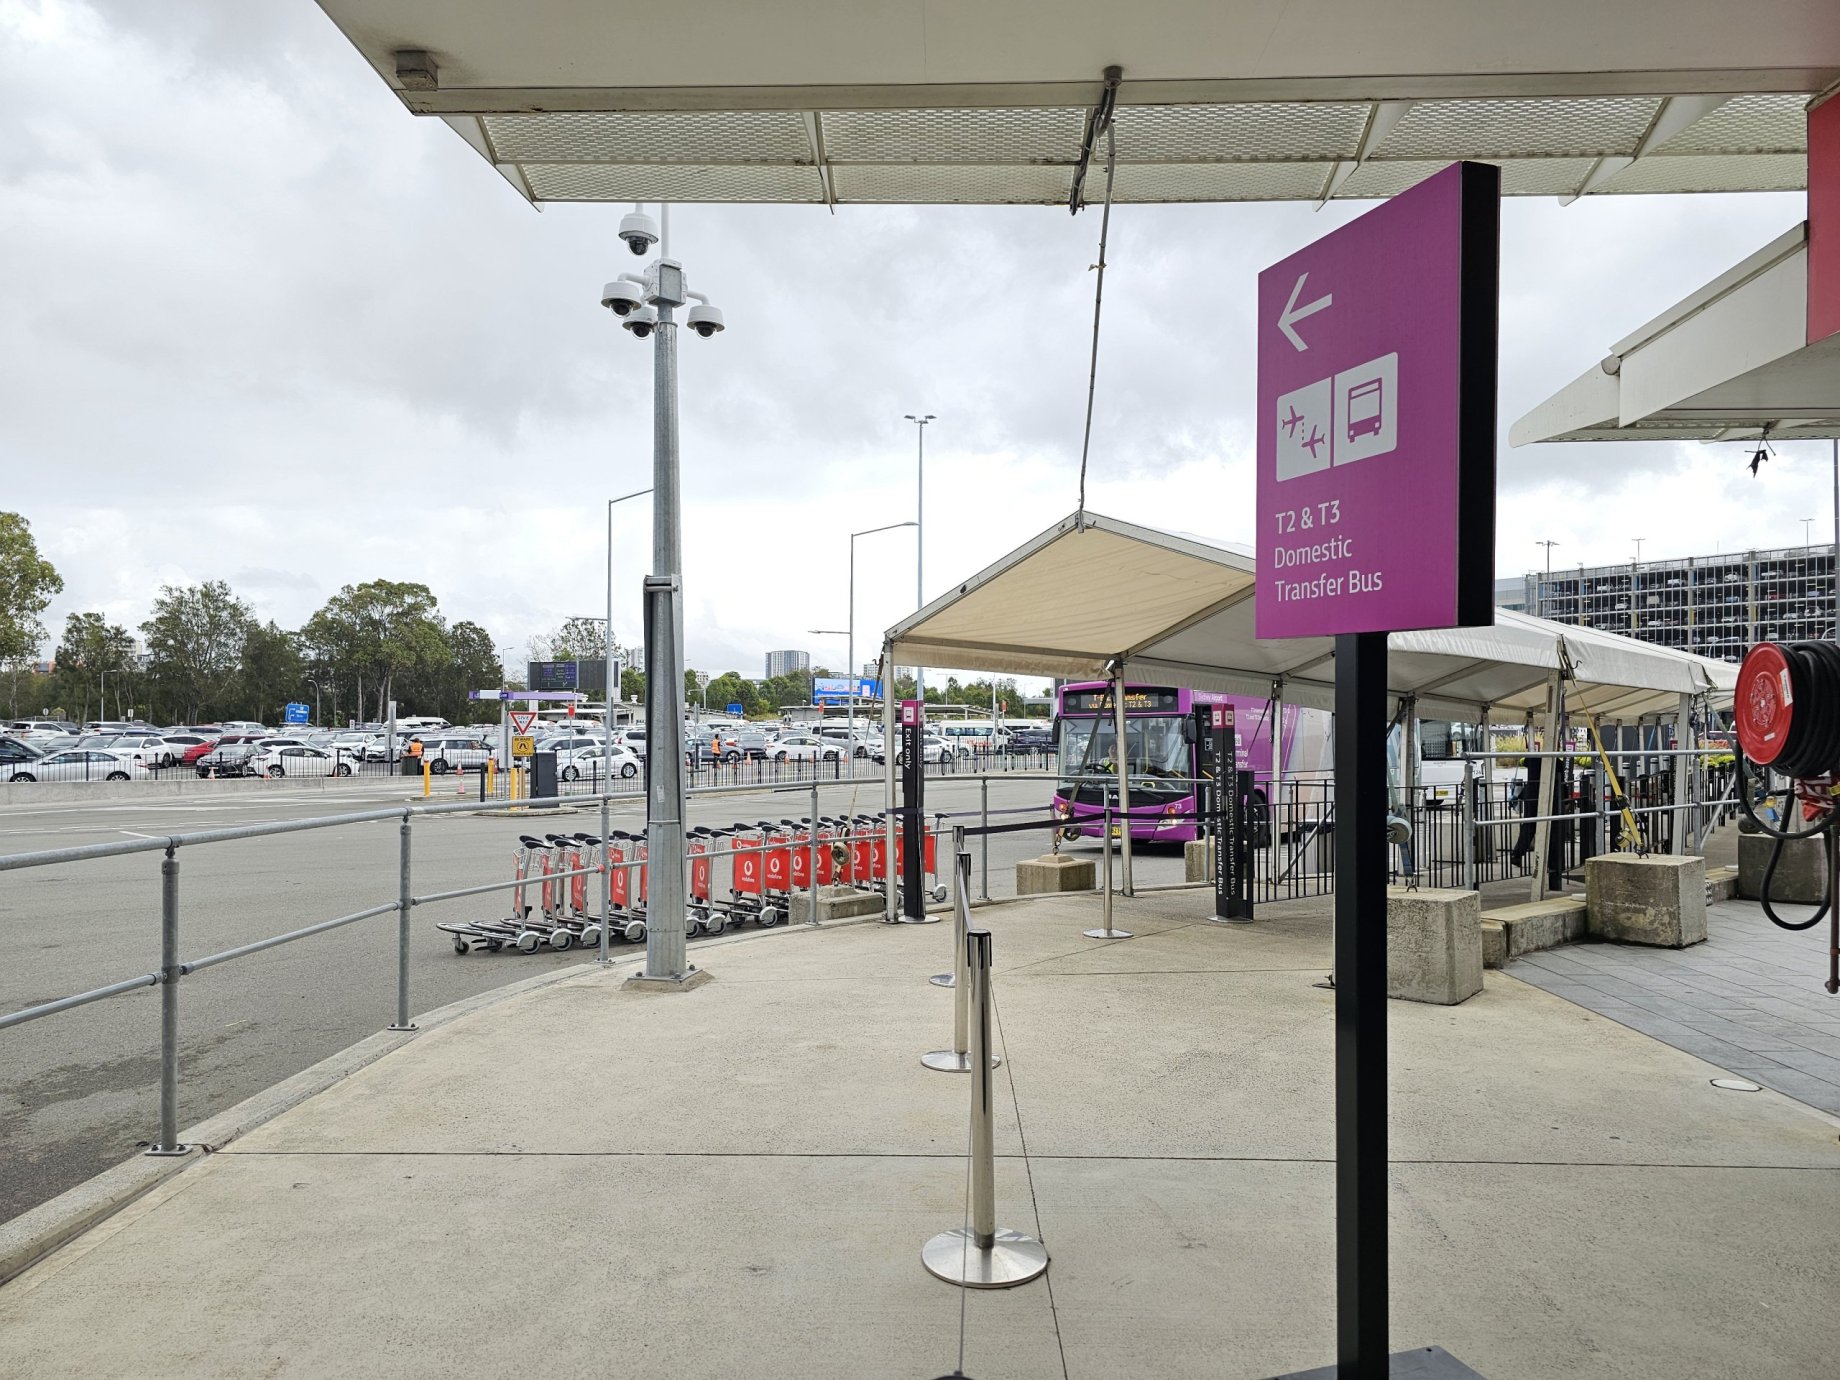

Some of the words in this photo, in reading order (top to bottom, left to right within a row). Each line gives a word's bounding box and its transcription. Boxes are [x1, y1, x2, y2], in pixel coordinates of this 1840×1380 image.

[1275, 511, 1296, 534] T2
[1300, 507, 1313, 529] &
[1318, 500, 1340, 525] T3
[1274, 534, 1353, 569] Domestic
[1274, 573, 1344, 602] Transfer
[1349, 570, 1383, 594] Bus
[904, 748, 912, 769] only
[1215, 751, 1221, 763] T2
[1227, 752, 1233, 763] T2
[1215, 776, 1221, 787] T3
[1228, 776, 1234, 787] T3
